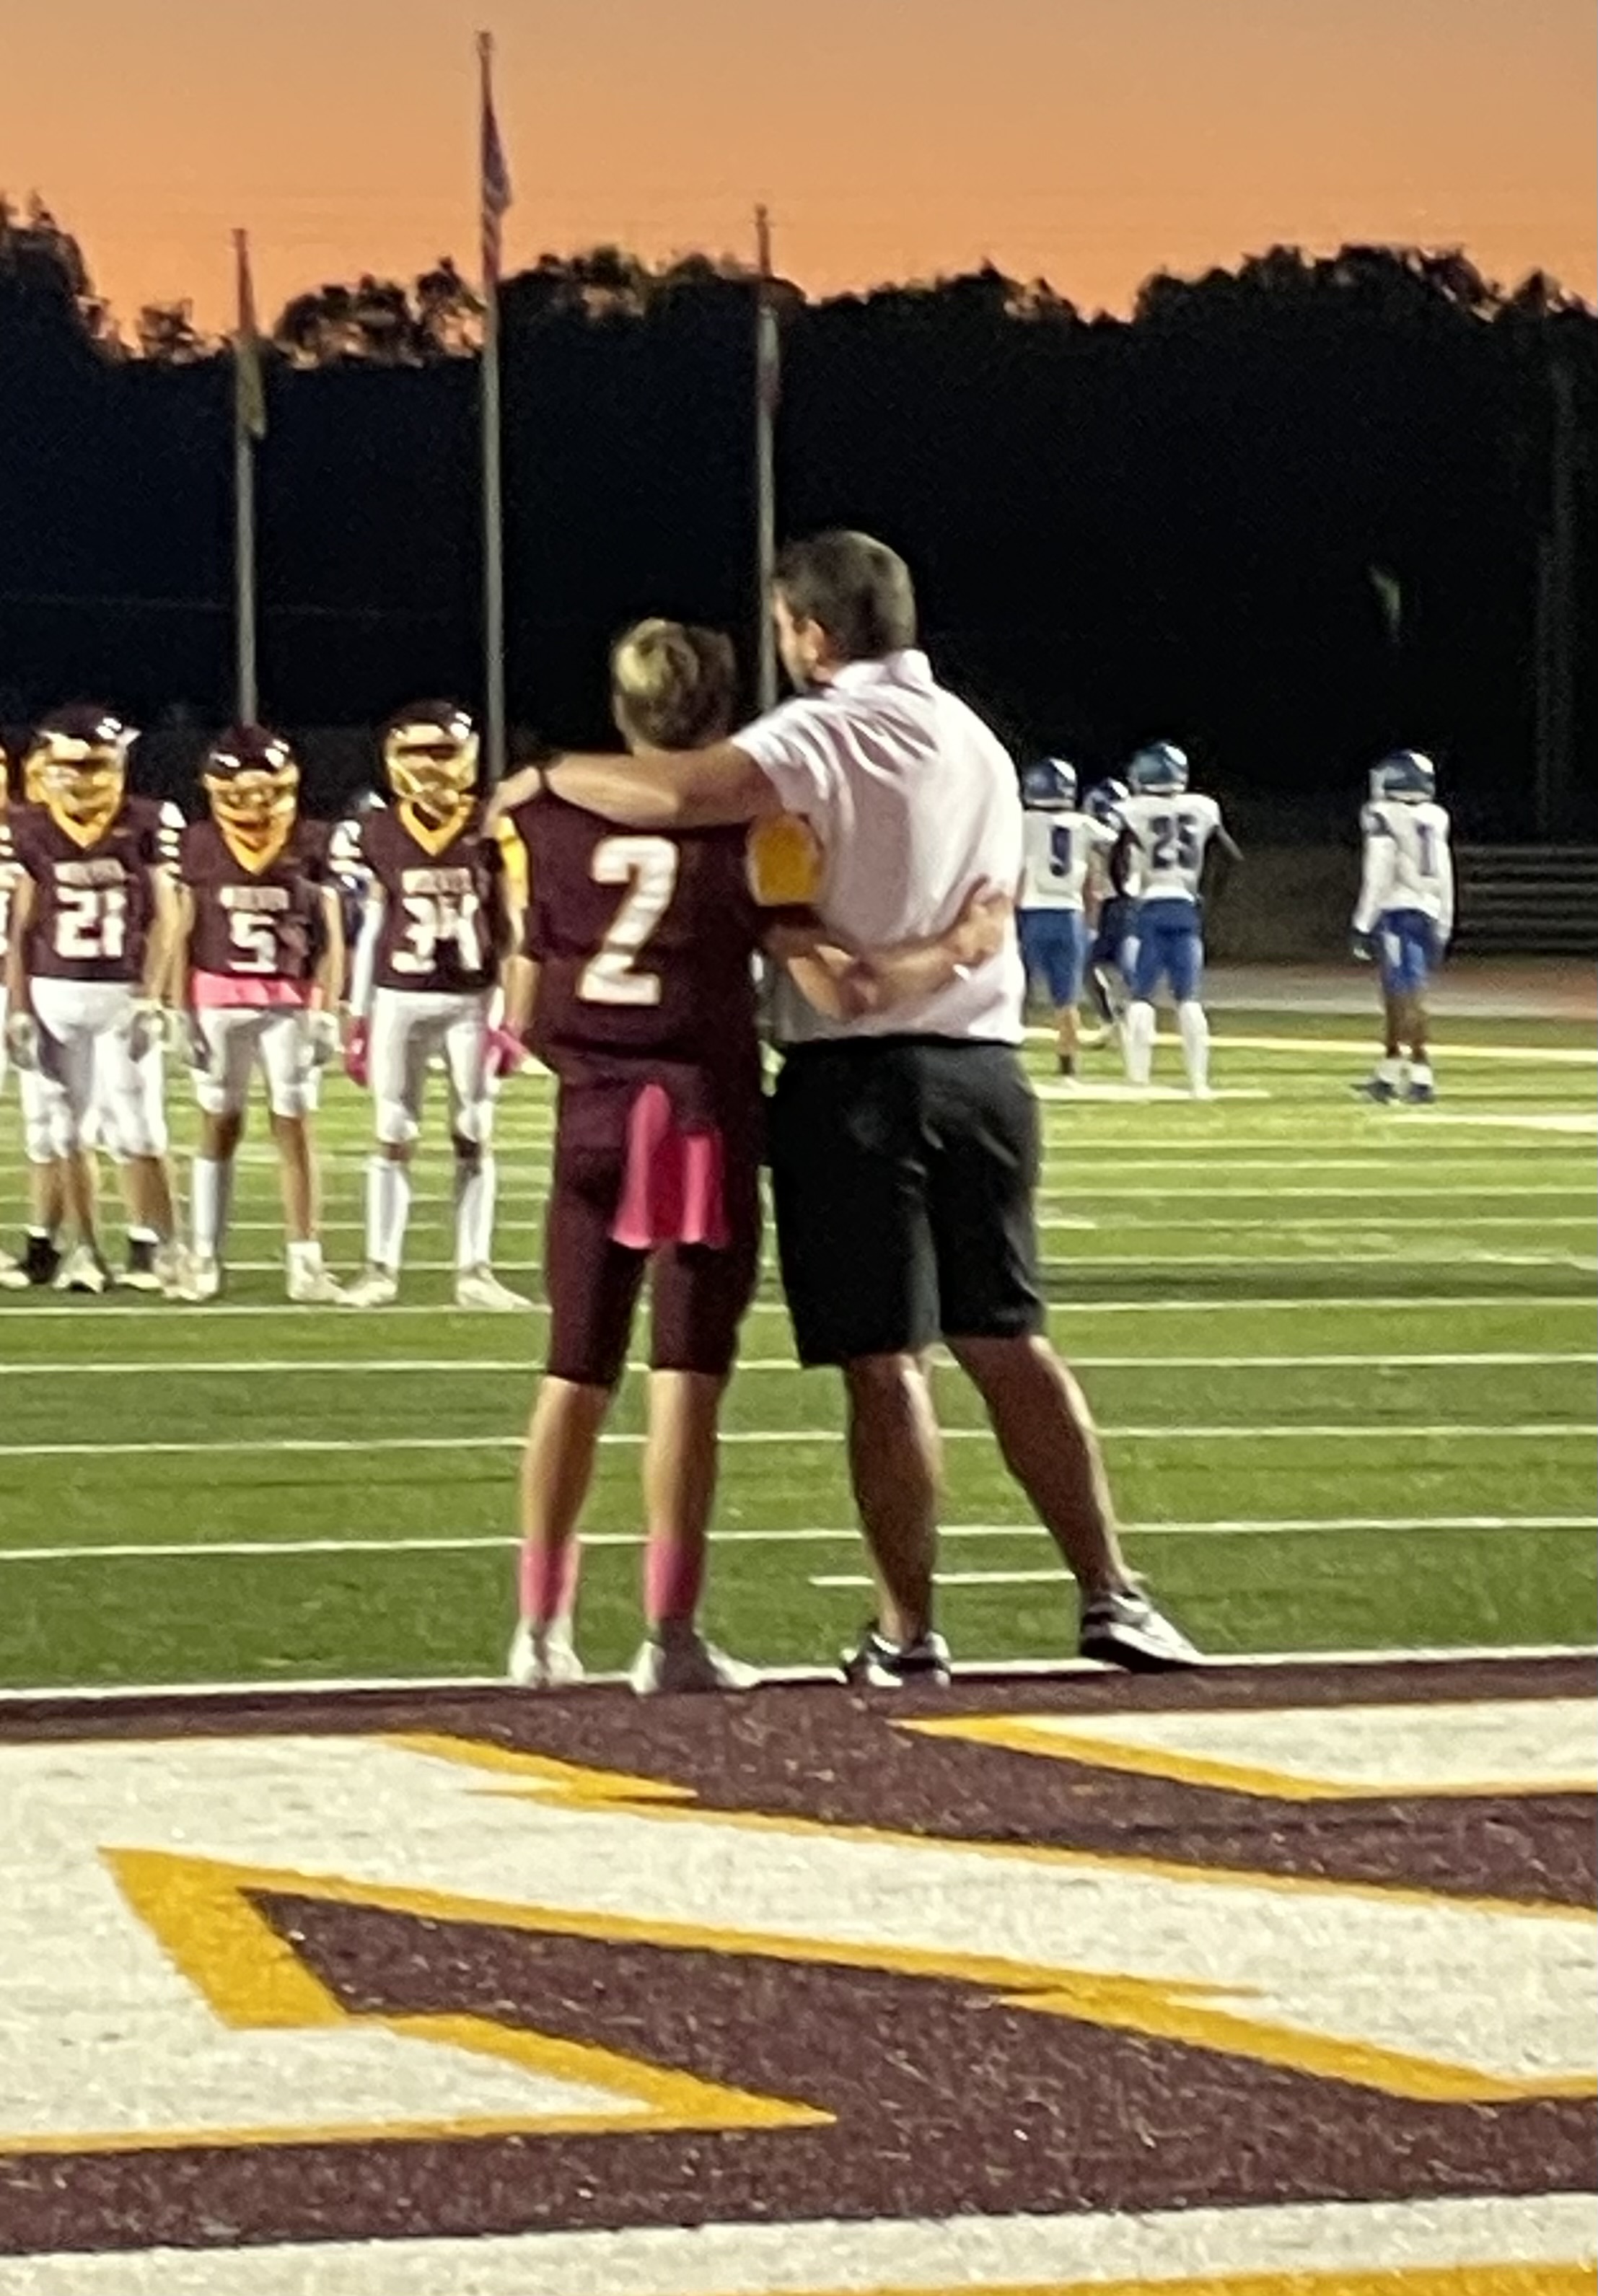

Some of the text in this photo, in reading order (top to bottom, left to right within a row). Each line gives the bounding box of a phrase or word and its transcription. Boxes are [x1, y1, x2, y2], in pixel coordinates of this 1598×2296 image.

[1050, 825, 1072, 877] 9
[55, 887, 127, 958] 21
[229, 913, 277, 973] 5
[392, 893, 482, 973] 34
[579, 836, 678, 1005] 2
